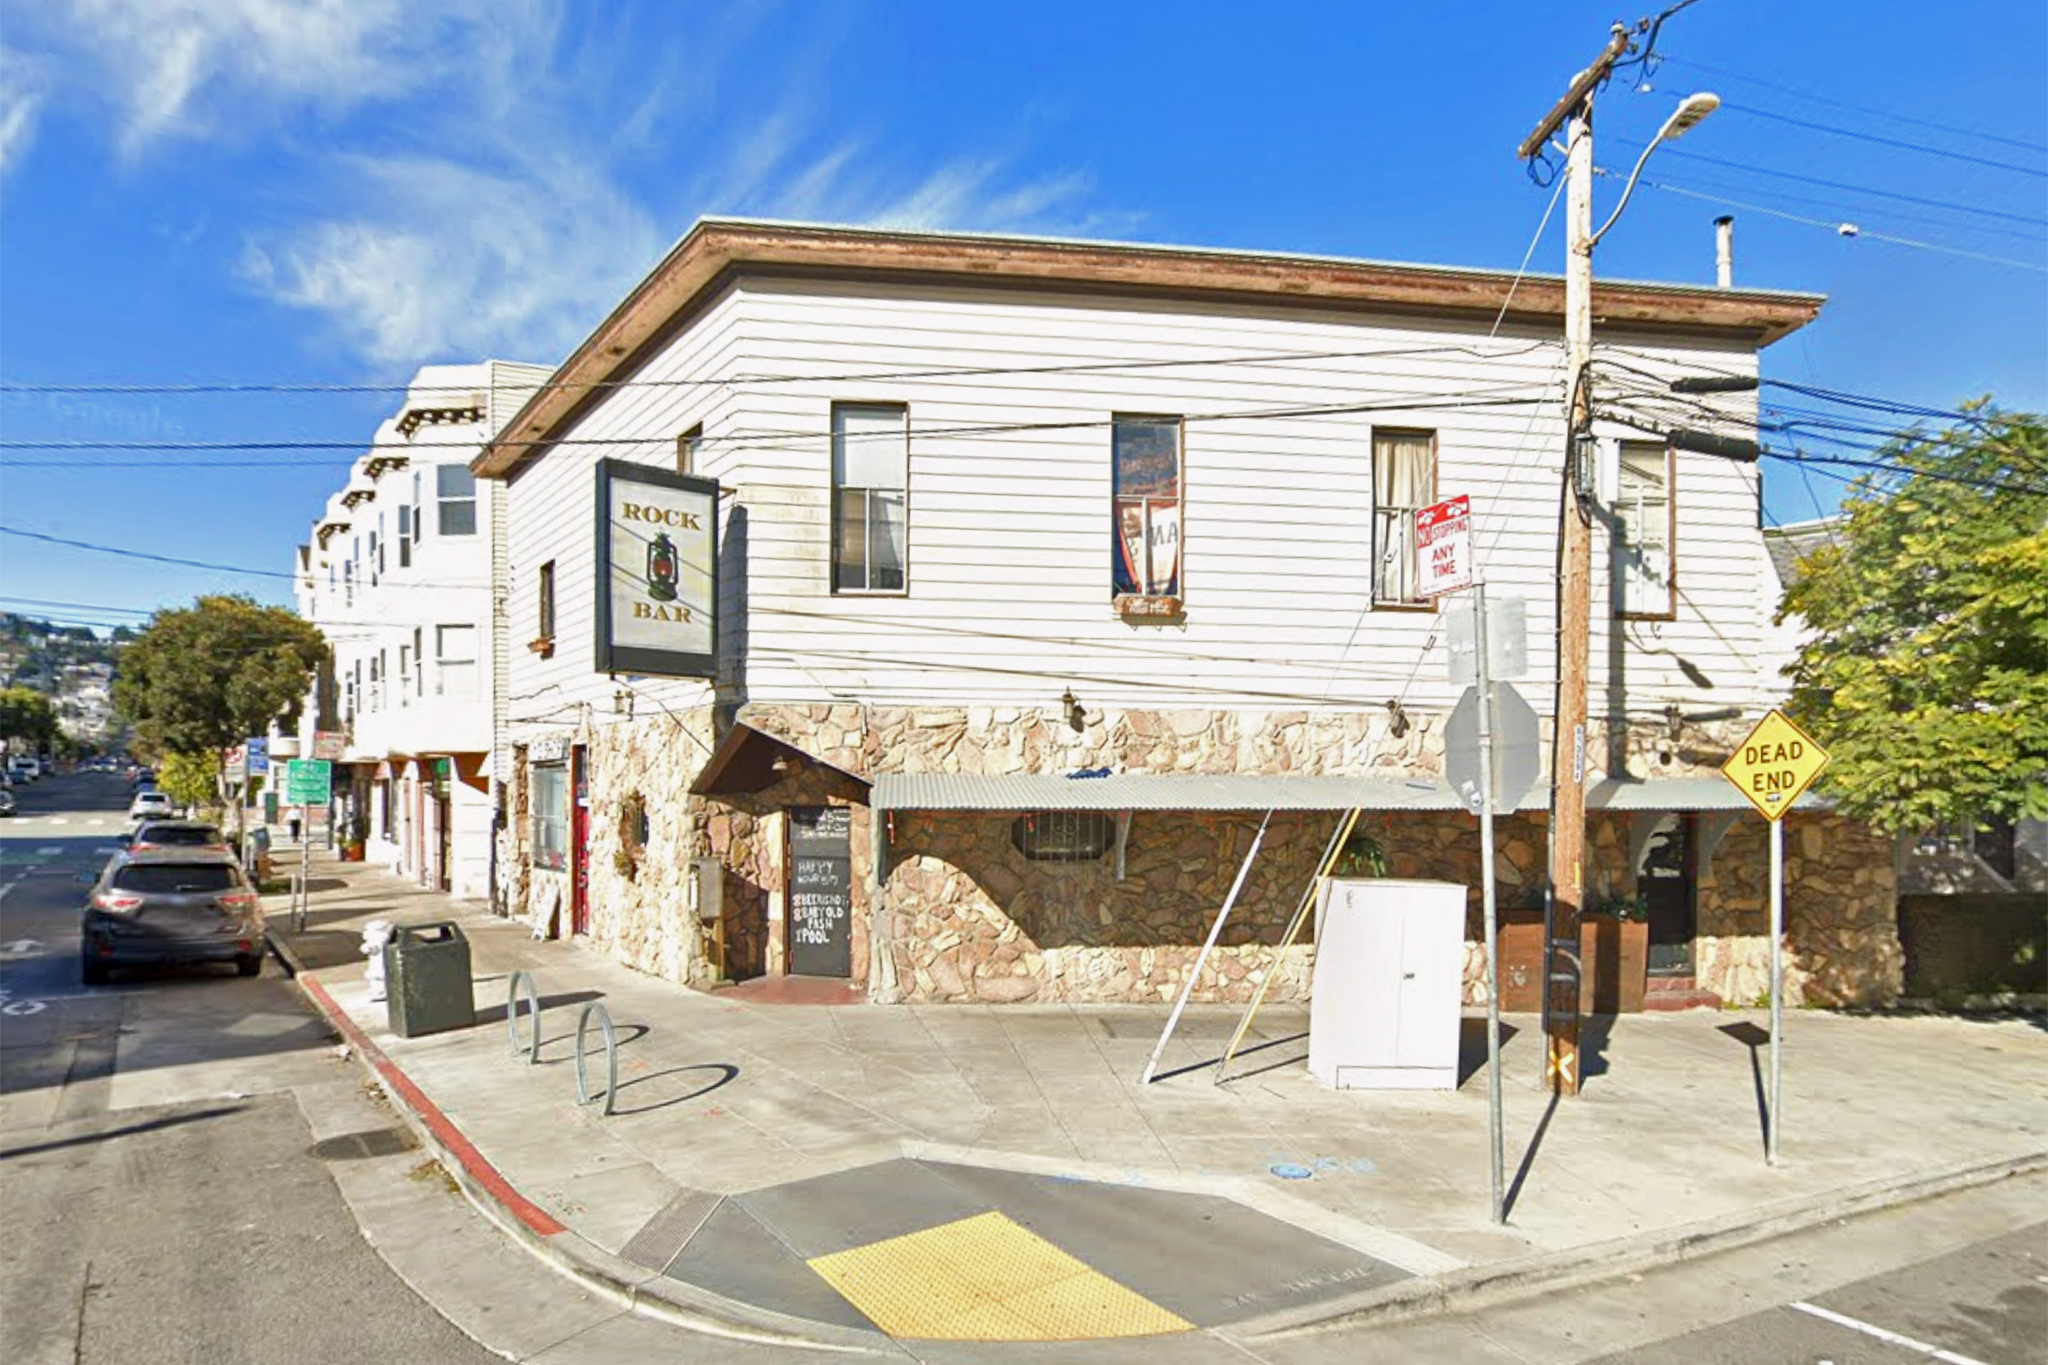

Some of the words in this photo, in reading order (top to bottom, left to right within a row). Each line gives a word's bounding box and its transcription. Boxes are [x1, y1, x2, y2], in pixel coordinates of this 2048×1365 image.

[622, 502, 702, 531] ROCK
[1432, 543, 1455, 562] ANY
[1432, 560, 1456, 579] TIME
[633, 601, 692, 624] BAR
[1746, 741, 1803, 765] DEAD
[1753, 770, 1795, 792] END
[798, 860, 833, 874] HAPPY
[826, 906, 844, 918] OLD
[807, 917, 833, 930] FASH
[802, 928, 830, 944] POOL
